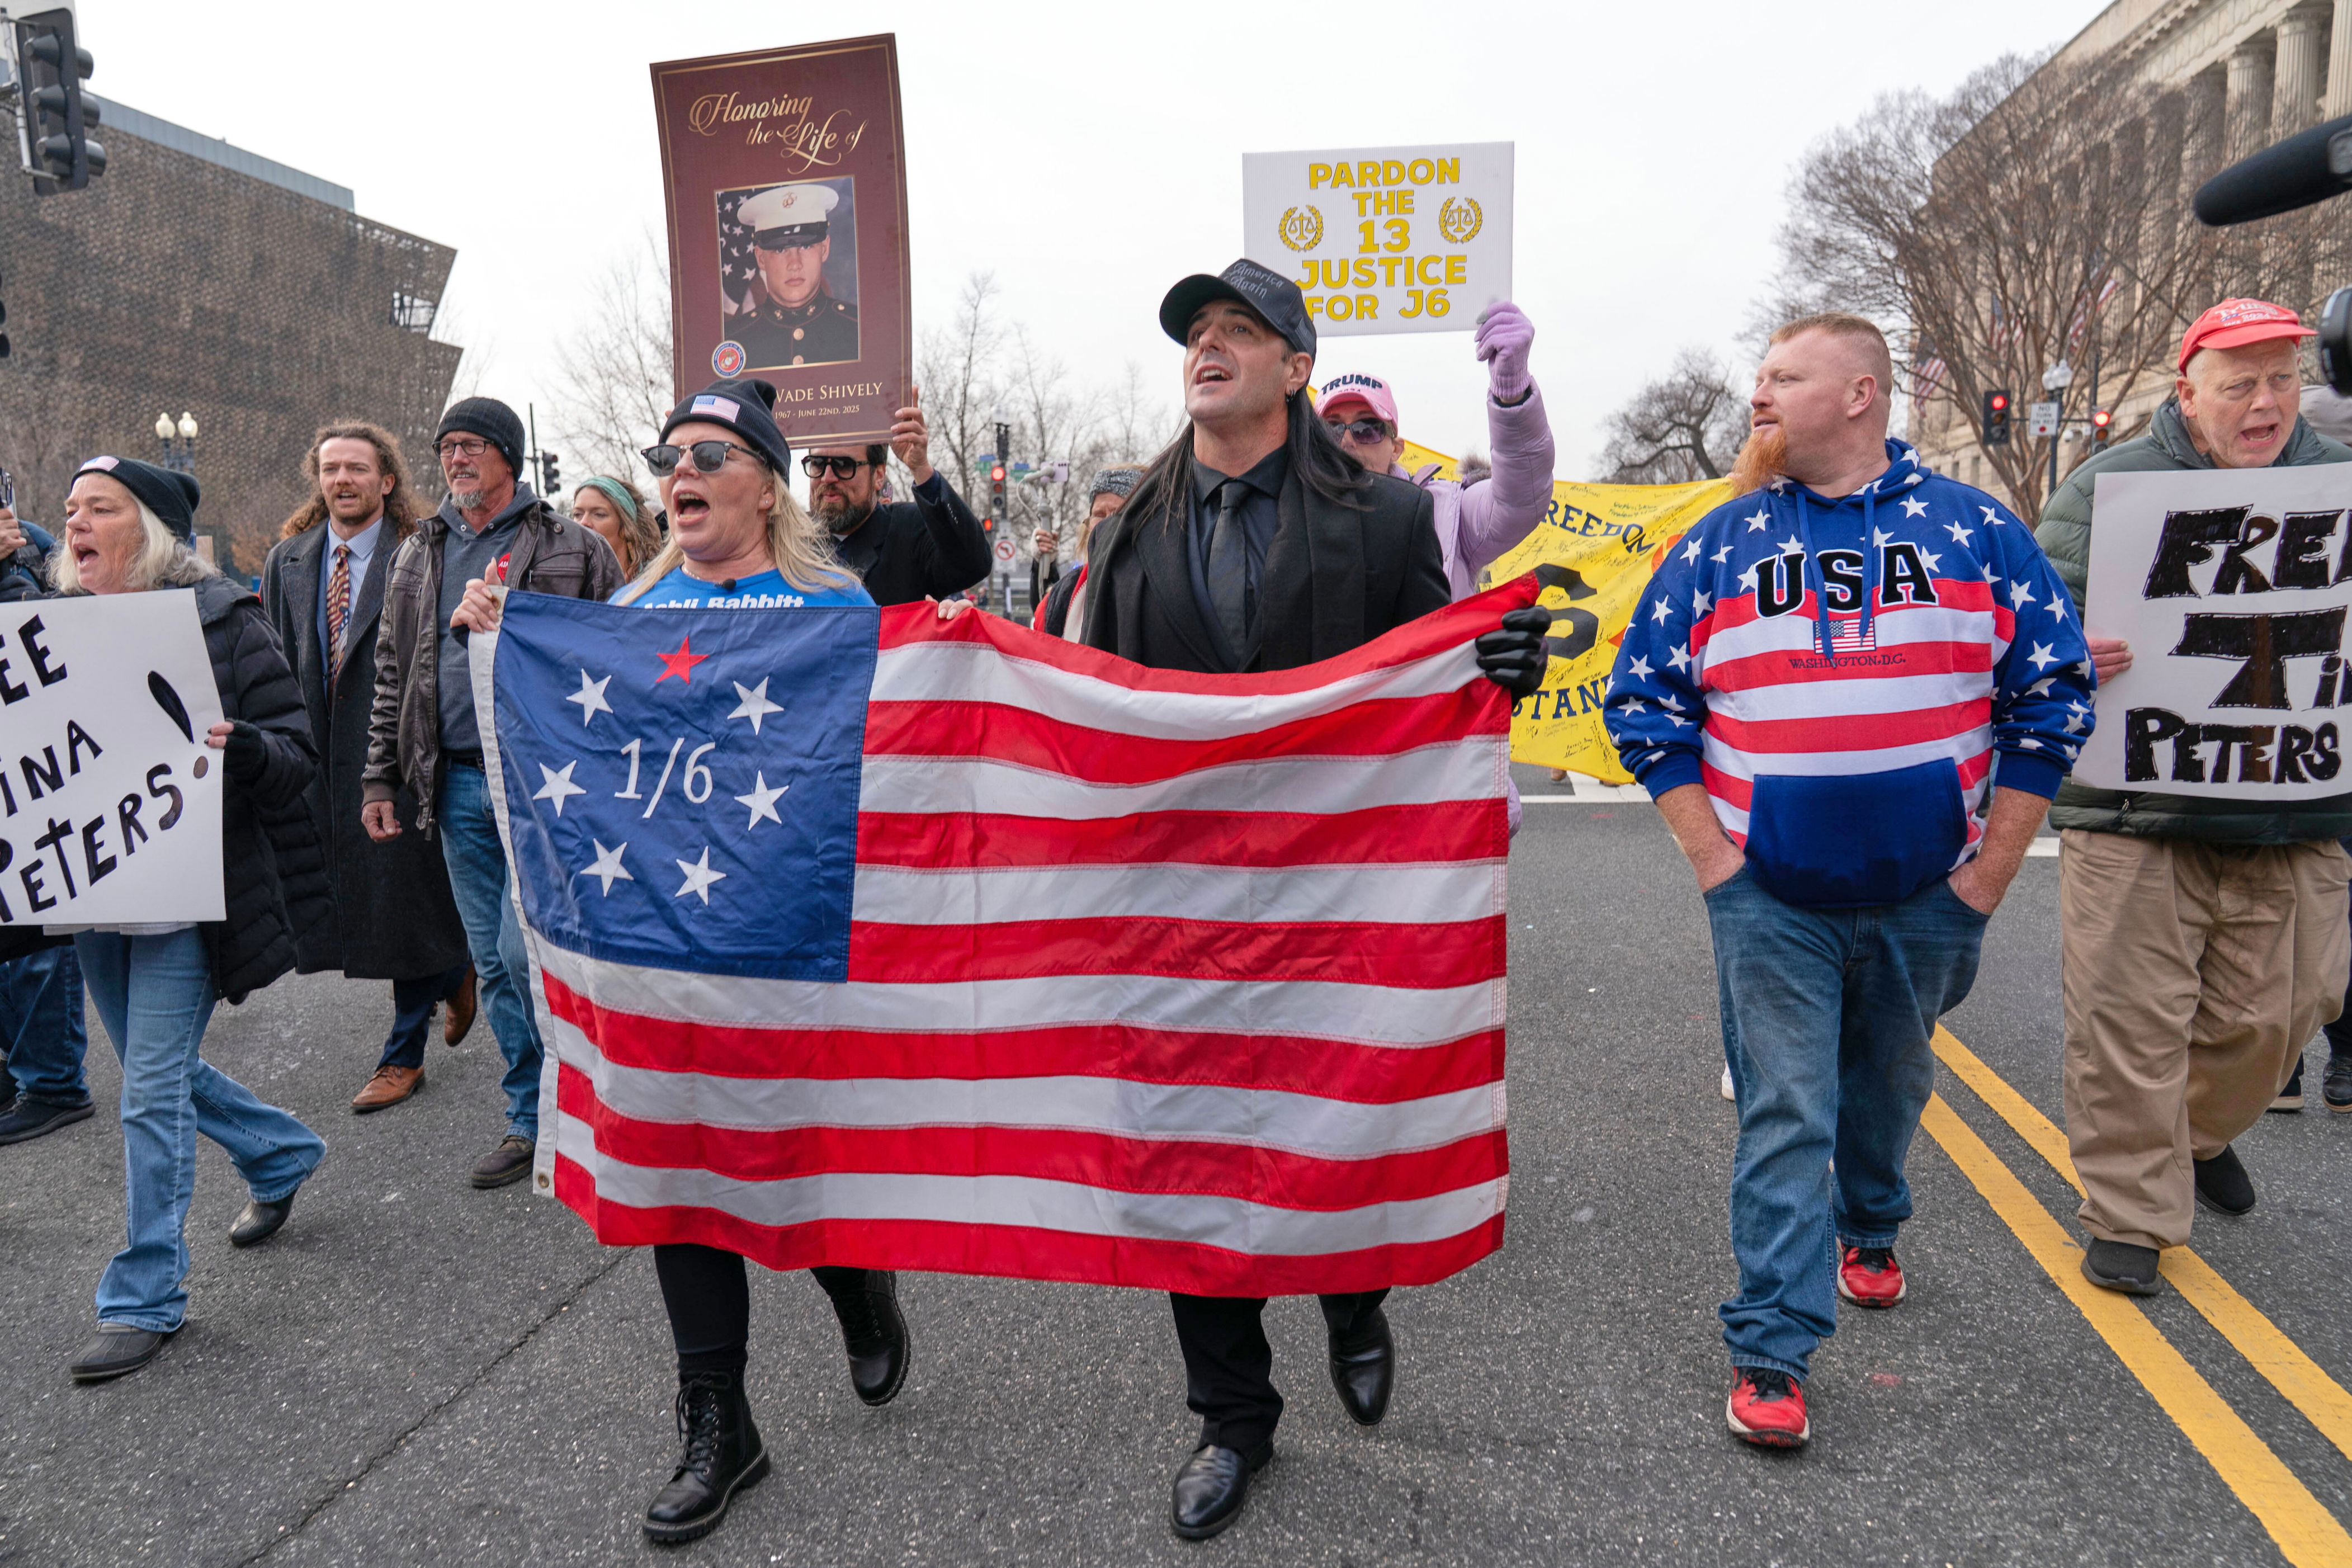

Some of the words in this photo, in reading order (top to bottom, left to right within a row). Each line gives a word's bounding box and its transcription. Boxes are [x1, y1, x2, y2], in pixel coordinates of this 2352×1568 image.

[688, 91, 813, 136] Honoring
[746, 121, 774, 145] the
[777, 108, 852, 174] Life
[845, 119, 869, 154] of
[1309, 157, 1461, 190] PARDON
[1352, 189, 1414, 216] THE
[1358, 218, 1410, 253] 13
[1294, 254, 1467, 290] JUSTICE
[1304, 294, 1378, 322] FOR
[1399, 289, 1450, 319] J6
[1321, 374, 1382, 395] TRUMP
[843, 404, 860, 414] 2025
[2142, 503, 2352, 600] FRE
[1753, 541, 1939, 620] USA
[2167, 604, 2352, 711] Ti
[1512, 674, 1610, 720] TAN
[2126, 707, 2341, 784] PETERS
[615, 737, 716, 819] 1/6
